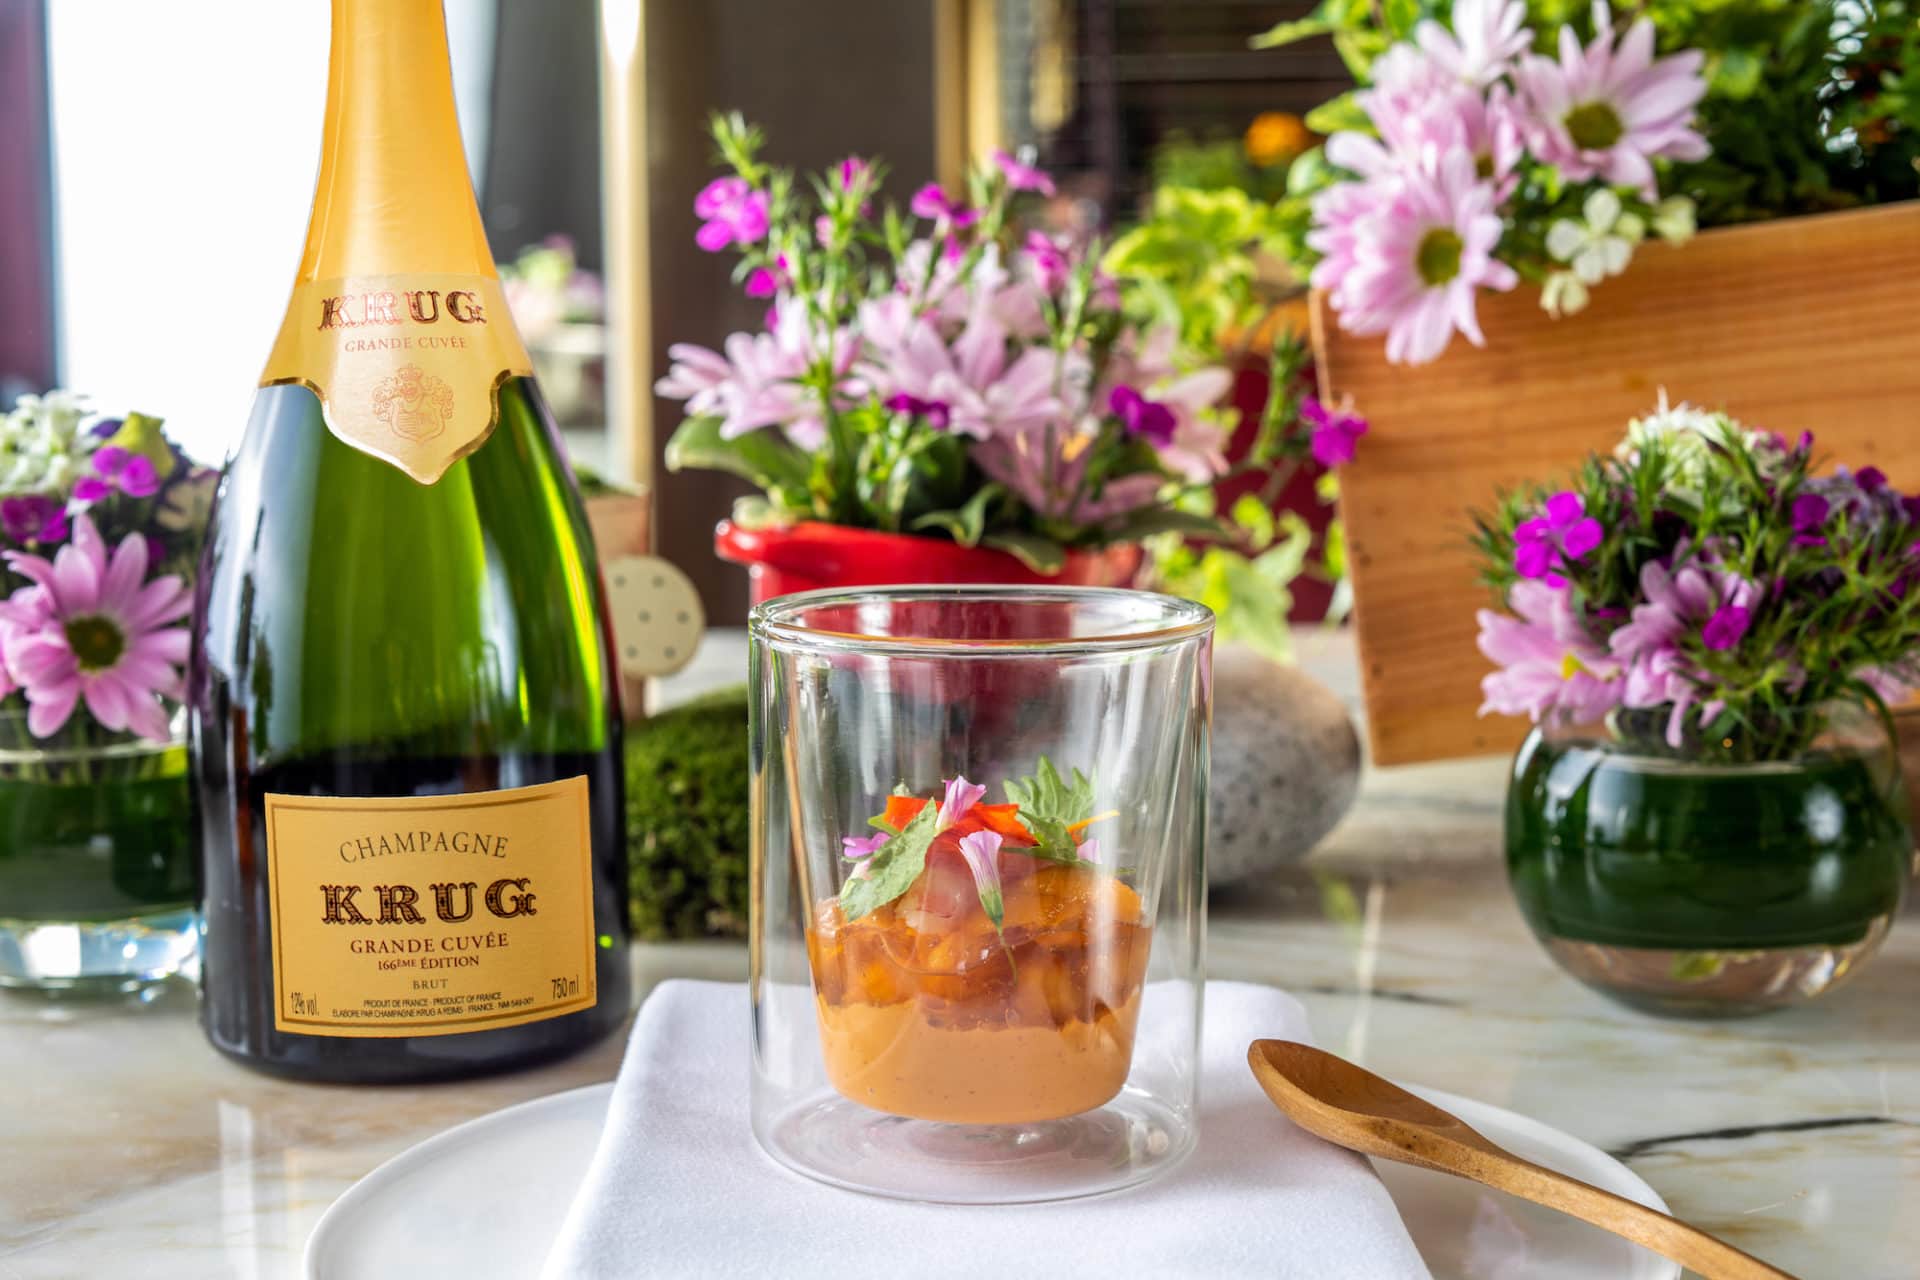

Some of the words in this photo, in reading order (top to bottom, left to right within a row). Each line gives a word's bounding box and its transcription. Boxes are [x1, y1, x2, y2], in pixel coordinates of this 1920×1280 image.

[318, 291, 487, 331] KRUG
[345, 337, 413, 352] GRANDE
[418, 335, 468, 349] CUVÉE
[340, 831, 509, 863] CHAMPAGNE
[320, 877, 537, 925] KRUG
[351, 938, 435, 954] GRANDE
[441, 931, 509, 950] CUVÉE
[420, 955, 479, 970] ÉDITION
[412, 978, 449, 990] BRUT
[551, 976, 568, 999] 750
[569, 974, 579, 994] ml
[290, 991, 305, 1014] 12%
[374, 1009, 414, 1017] CHAMPAGNE
[415, 1007, 436, 1016] KRUG
[468, 1003, 494, 1012] FRANCE
[402, 999, 428, 1007] FRANCE
[433, 997, 465, 1006] PRODUCT
[475, 992, 502, 1002] FRANCE
